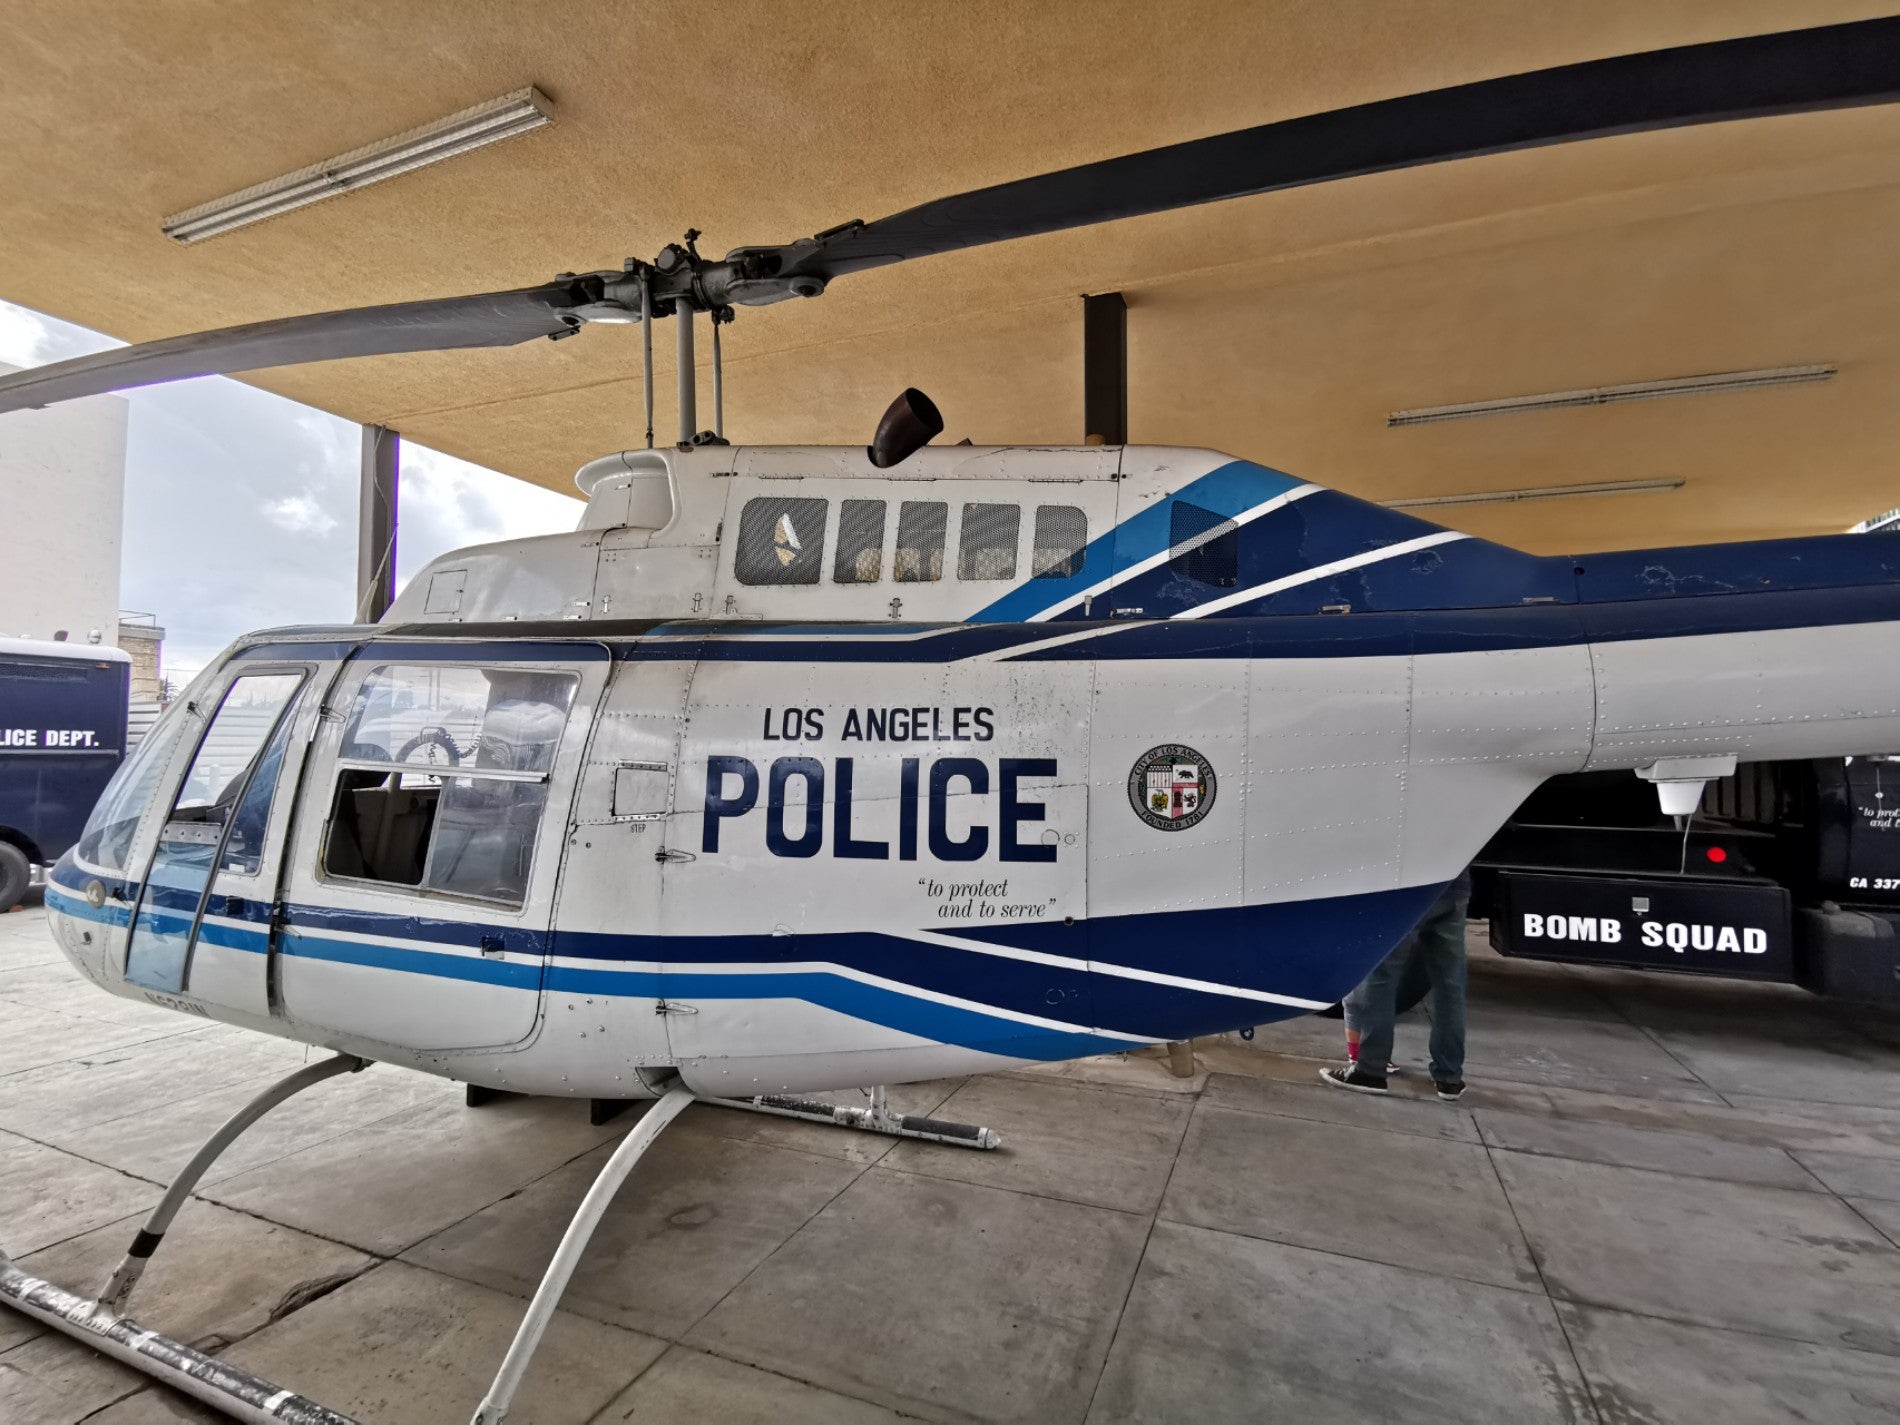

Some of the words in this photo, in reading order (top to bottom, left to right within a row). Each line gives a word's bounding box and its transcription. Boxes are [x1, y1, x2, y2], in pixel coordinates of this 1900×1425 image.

[763, 707, 825, 742] LOS
[841, 707, 995, 742] ANGELES
[45, 729, 99, 747] DEPT.
[1134, 758, 1149, 776] CITY
[1148, 749, 1160, 761] OF
[1161, 746, 1178, 755] LOS
[1180, 748, 1212, 777] ANGELES
[702, 755, 1058, 863] POLICE
[630, 823, 647, 834] STEP
[1141, 810, 1182, 829] FOUNDED
[1184, 811, 1204, 826] 1781
[949, 879, 1009, 901] protect
[1850, 877, 1868, 888] CA
[938, 899, 973, 918] and
[980, 899, 996, 918] to
[1524, 913, 1622, 943] BOMB
[1641, 921, 1767, 954] SQUAD
